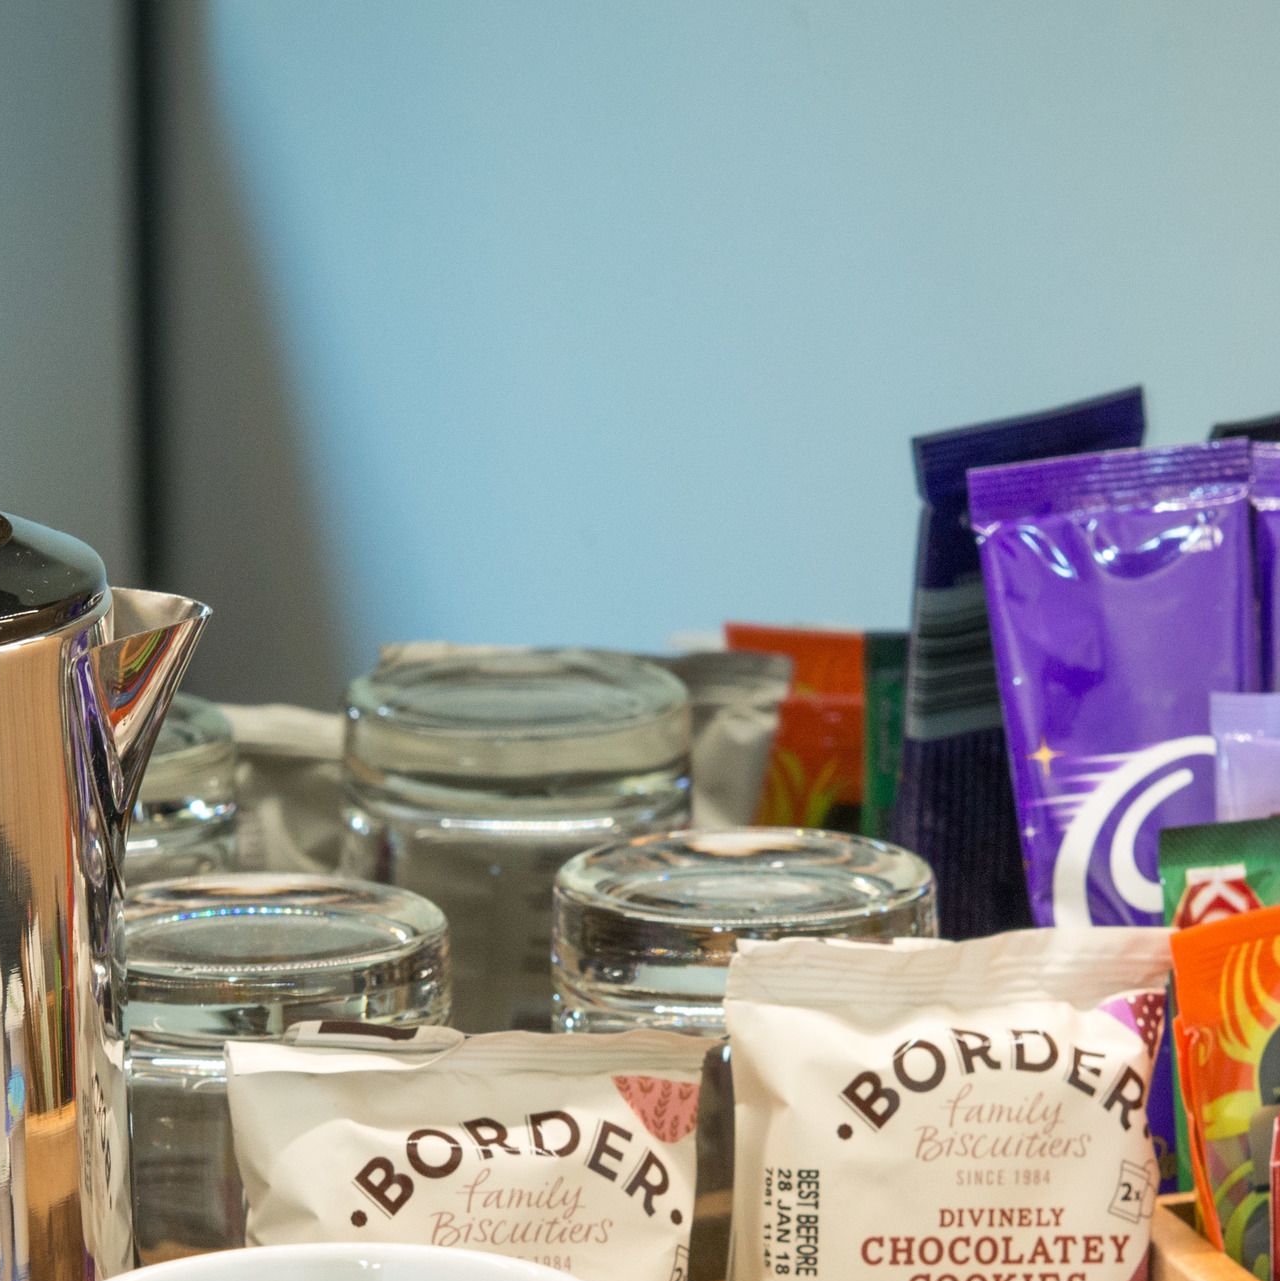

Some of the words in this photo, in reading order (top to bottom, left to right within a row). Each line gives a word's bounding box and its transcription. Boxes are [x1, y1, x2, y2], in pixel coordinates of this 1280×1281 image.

[838, 1028, 1145, 1132] BORDER
[915, 1126, 1092, 1162] Biscuitiers
[351, 1110, 669, 1220] BORDER
[777, 1168, 793, 1192] 28
[956, 1169, 1005, 1186] SINCE
[1014, 1169, 1051, 1186] 1984
[796, 1168, 820, 1210] BEST
[430, 1211, 613, 1246] Biscuitiers
[776, 1199, 792, 1243] JAN
[938, 1207, 1065, 1228] DIVINELY
[795, 1214, 819, 1277] BEFORE
[860, 1234, 1131, 1267] CHOCOLATEY
[775, 1252, 790, 1275] 18
